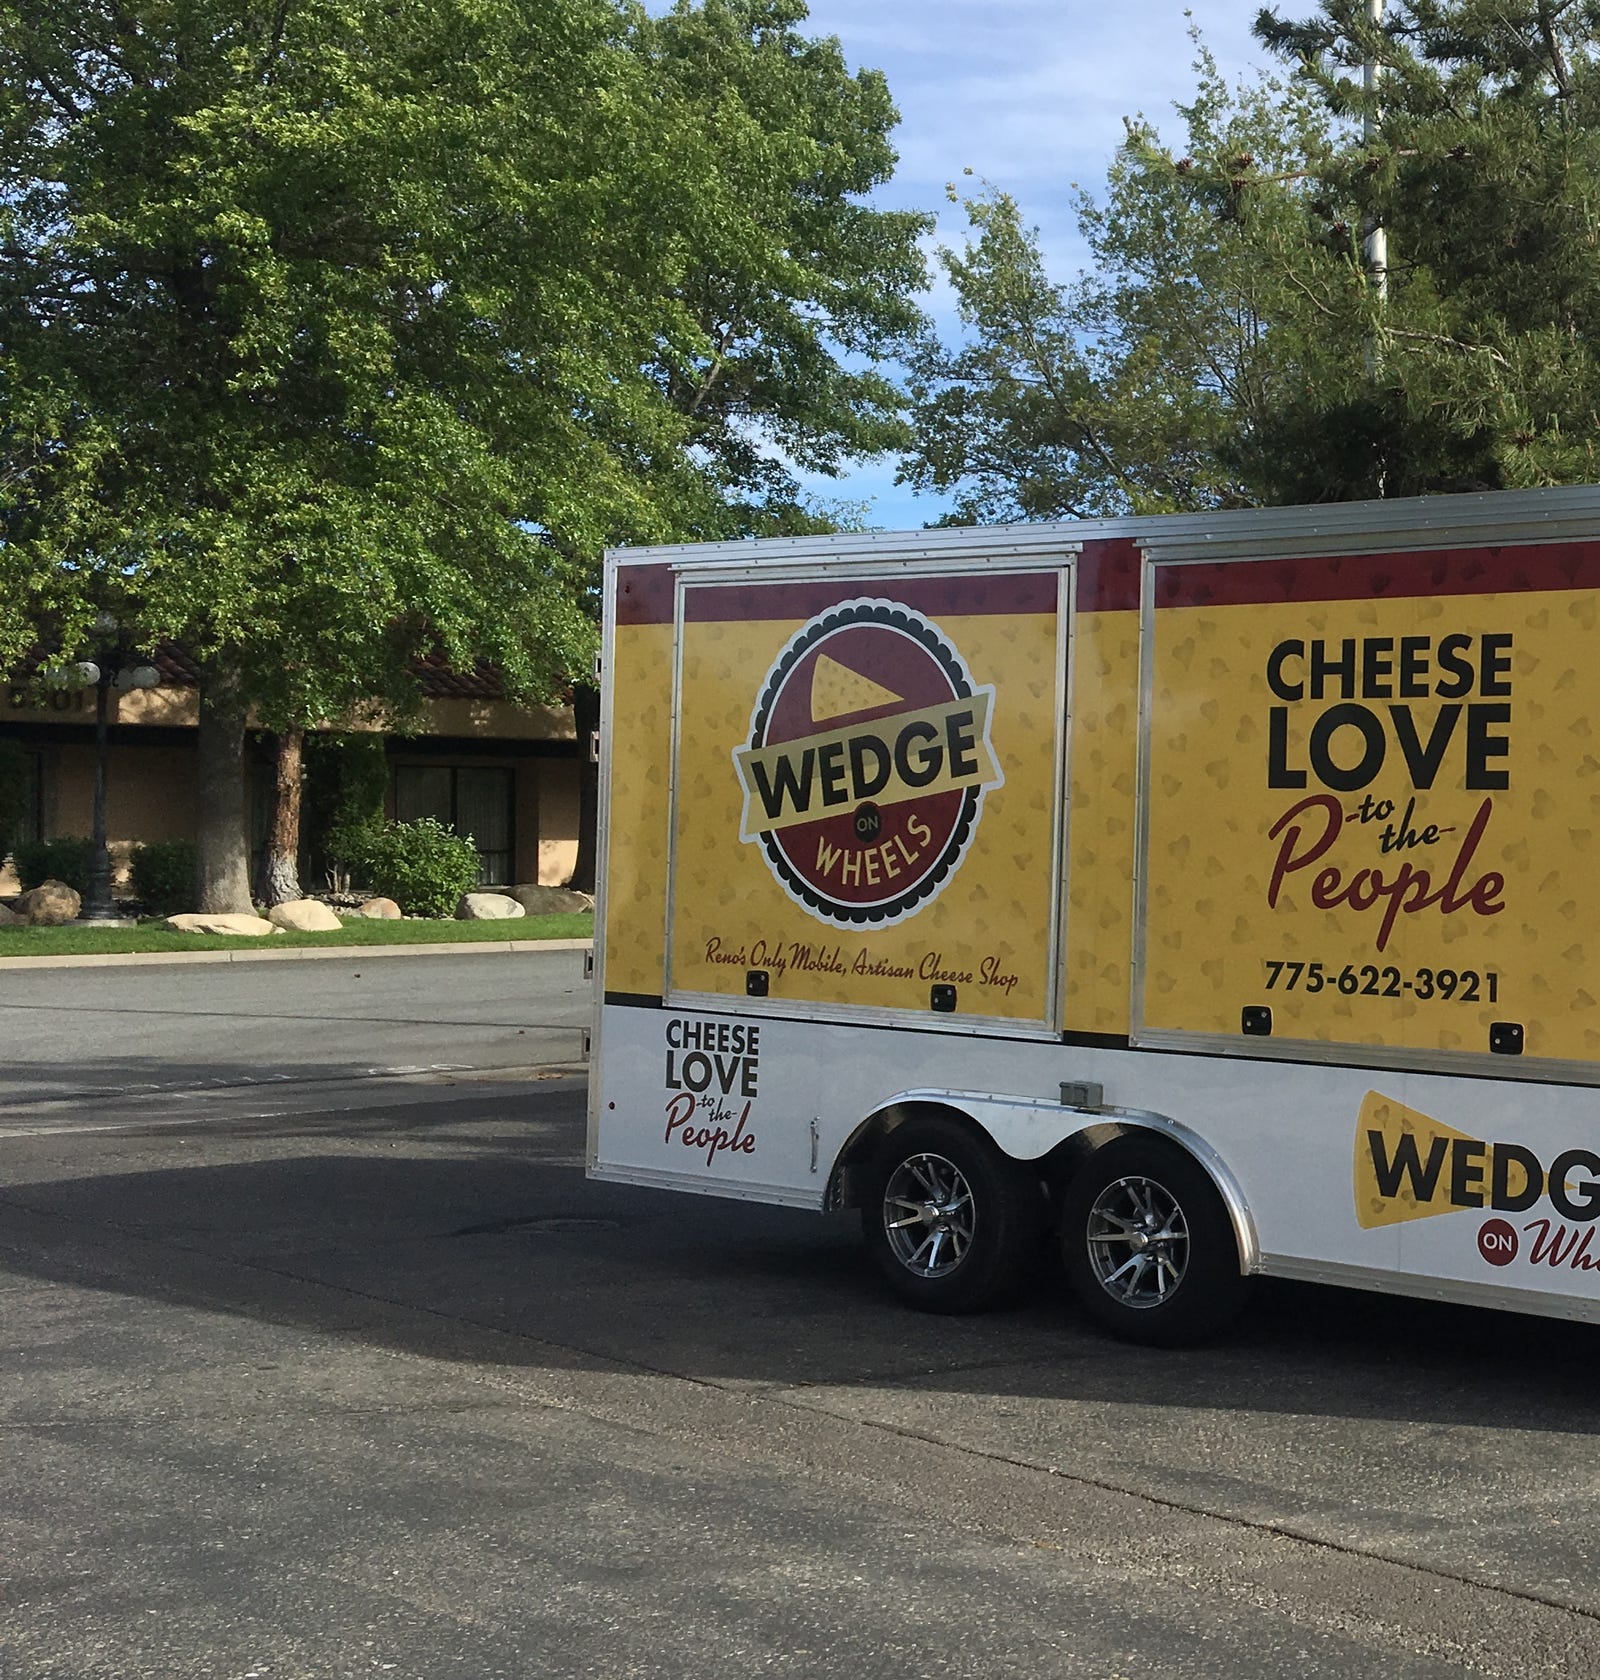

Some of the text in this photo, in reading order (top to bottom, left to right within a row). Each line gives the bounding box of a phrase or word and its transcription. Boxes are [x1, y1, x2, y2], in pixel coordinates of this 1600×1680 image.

[1266, 633, 1513, 702] CHEESE
[752, 710, 979, 820] WEDGE
[1266, 703, 1512, 792] LOVE
[815, 813, 932, 887] WHEELS
[856, 815, 879, 831] ON
[1267, 793, 1506, 953] People
[705, 936, 1019, 996] Reno's Only Mobile, Artisan Cheese Shop
[1264, 960, 1499, 1003] 775-622-3921
[666, 1018, 760, 1056] CHEESE
[665, 1049, 759, 1098] LOVE
[665, 1092, 756, 1168] People
[1483, 1232, 1513, 1253] ON
